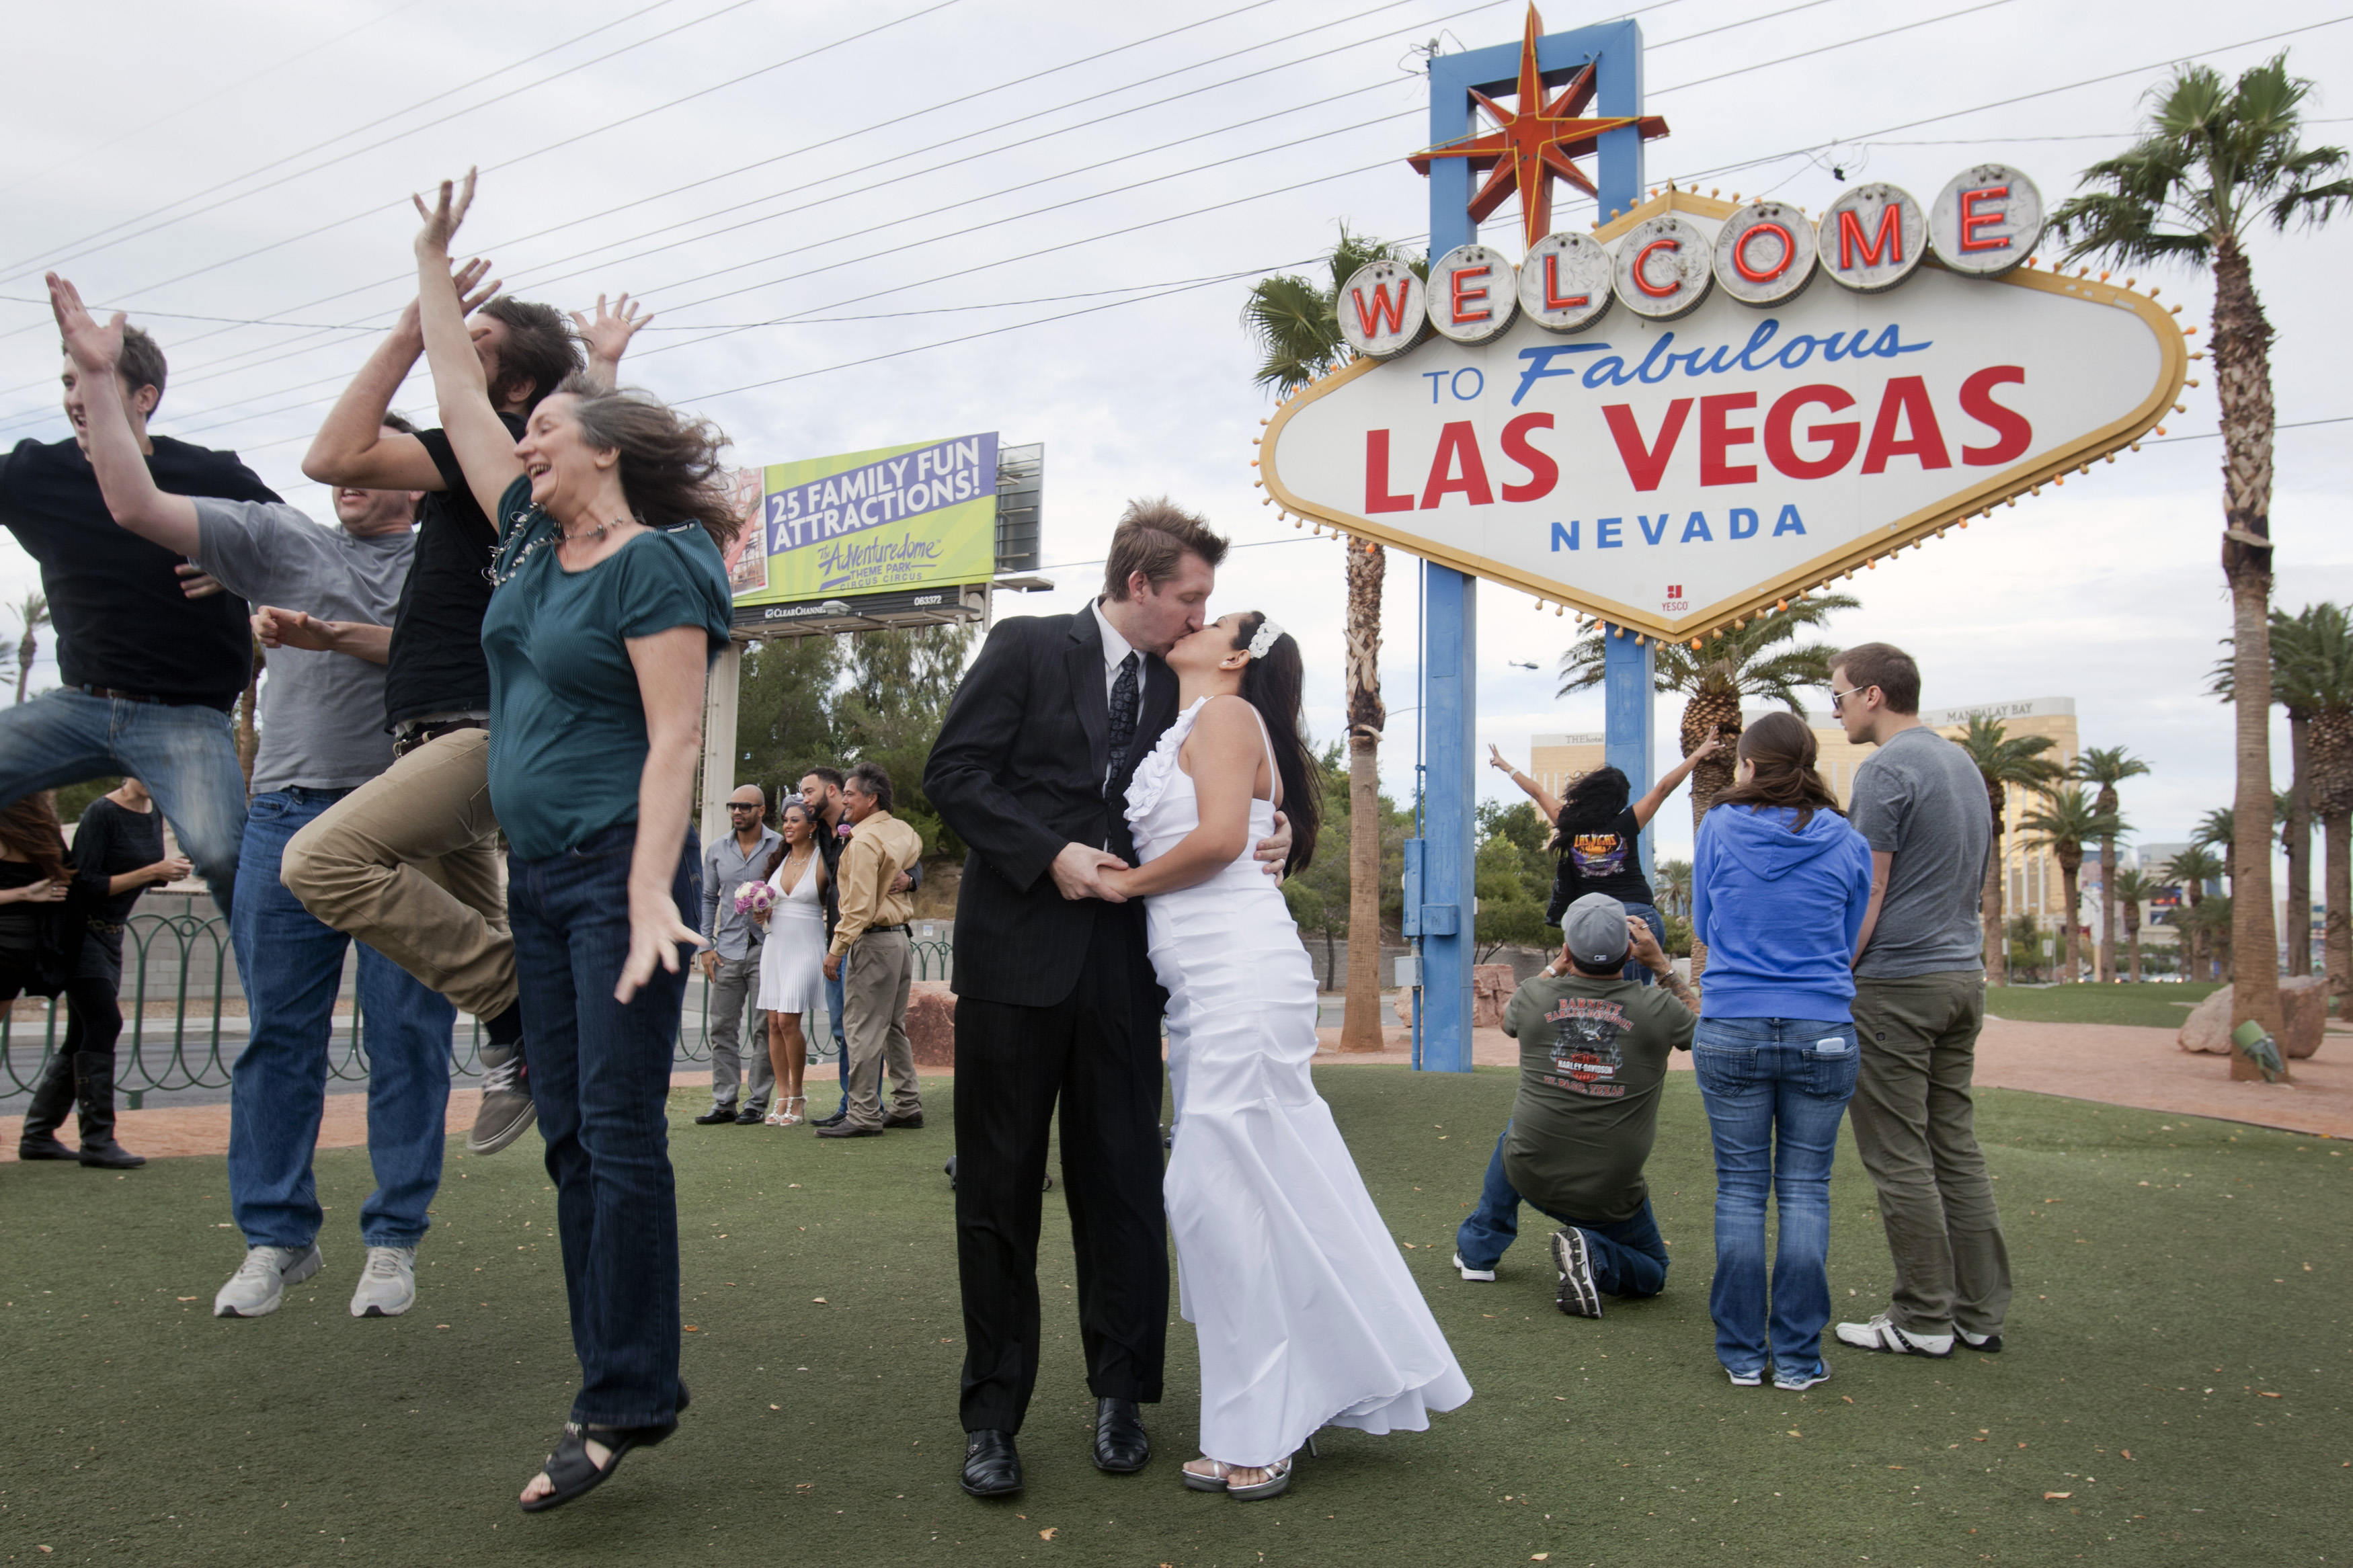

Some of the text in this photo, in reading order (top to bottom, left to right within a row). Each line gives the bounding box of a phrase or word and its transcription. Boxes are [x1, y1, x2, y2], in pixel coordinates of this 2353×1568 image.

[1351, 183, 2011, 339] WELCOME
[1422, 318, 1933, 407] TO Fabulous
[1365, 365, 2033, 514] LAS VEGAS
[772, 437, 979, 524] 25 FAMILY FUN
[773, 466, 981, 552] ATTRACTIONS!
[1550, 504, 1807, 552] NEVADA
[850, 562, 912, 580] THEME PARK
[840, 573, 922, 591] CIRCUS CIRCUS
[914, 595, 942, 606] 063372
[1661, 601, 1688, 612] YESCO
[1946, 703, 2032, 723] MANDALAY BAY
[1574, 834, 1590, 848] LAS
[1558, 998, 1623, 1015] BARNETT
[1544, 1009, 1634, 1032] HARLEY-DAVIDSON
[1558, 1059, 1613, 1074] HARLEY-DAVIDSON
[1589, 1083, 1626, 1096] TEXAS
